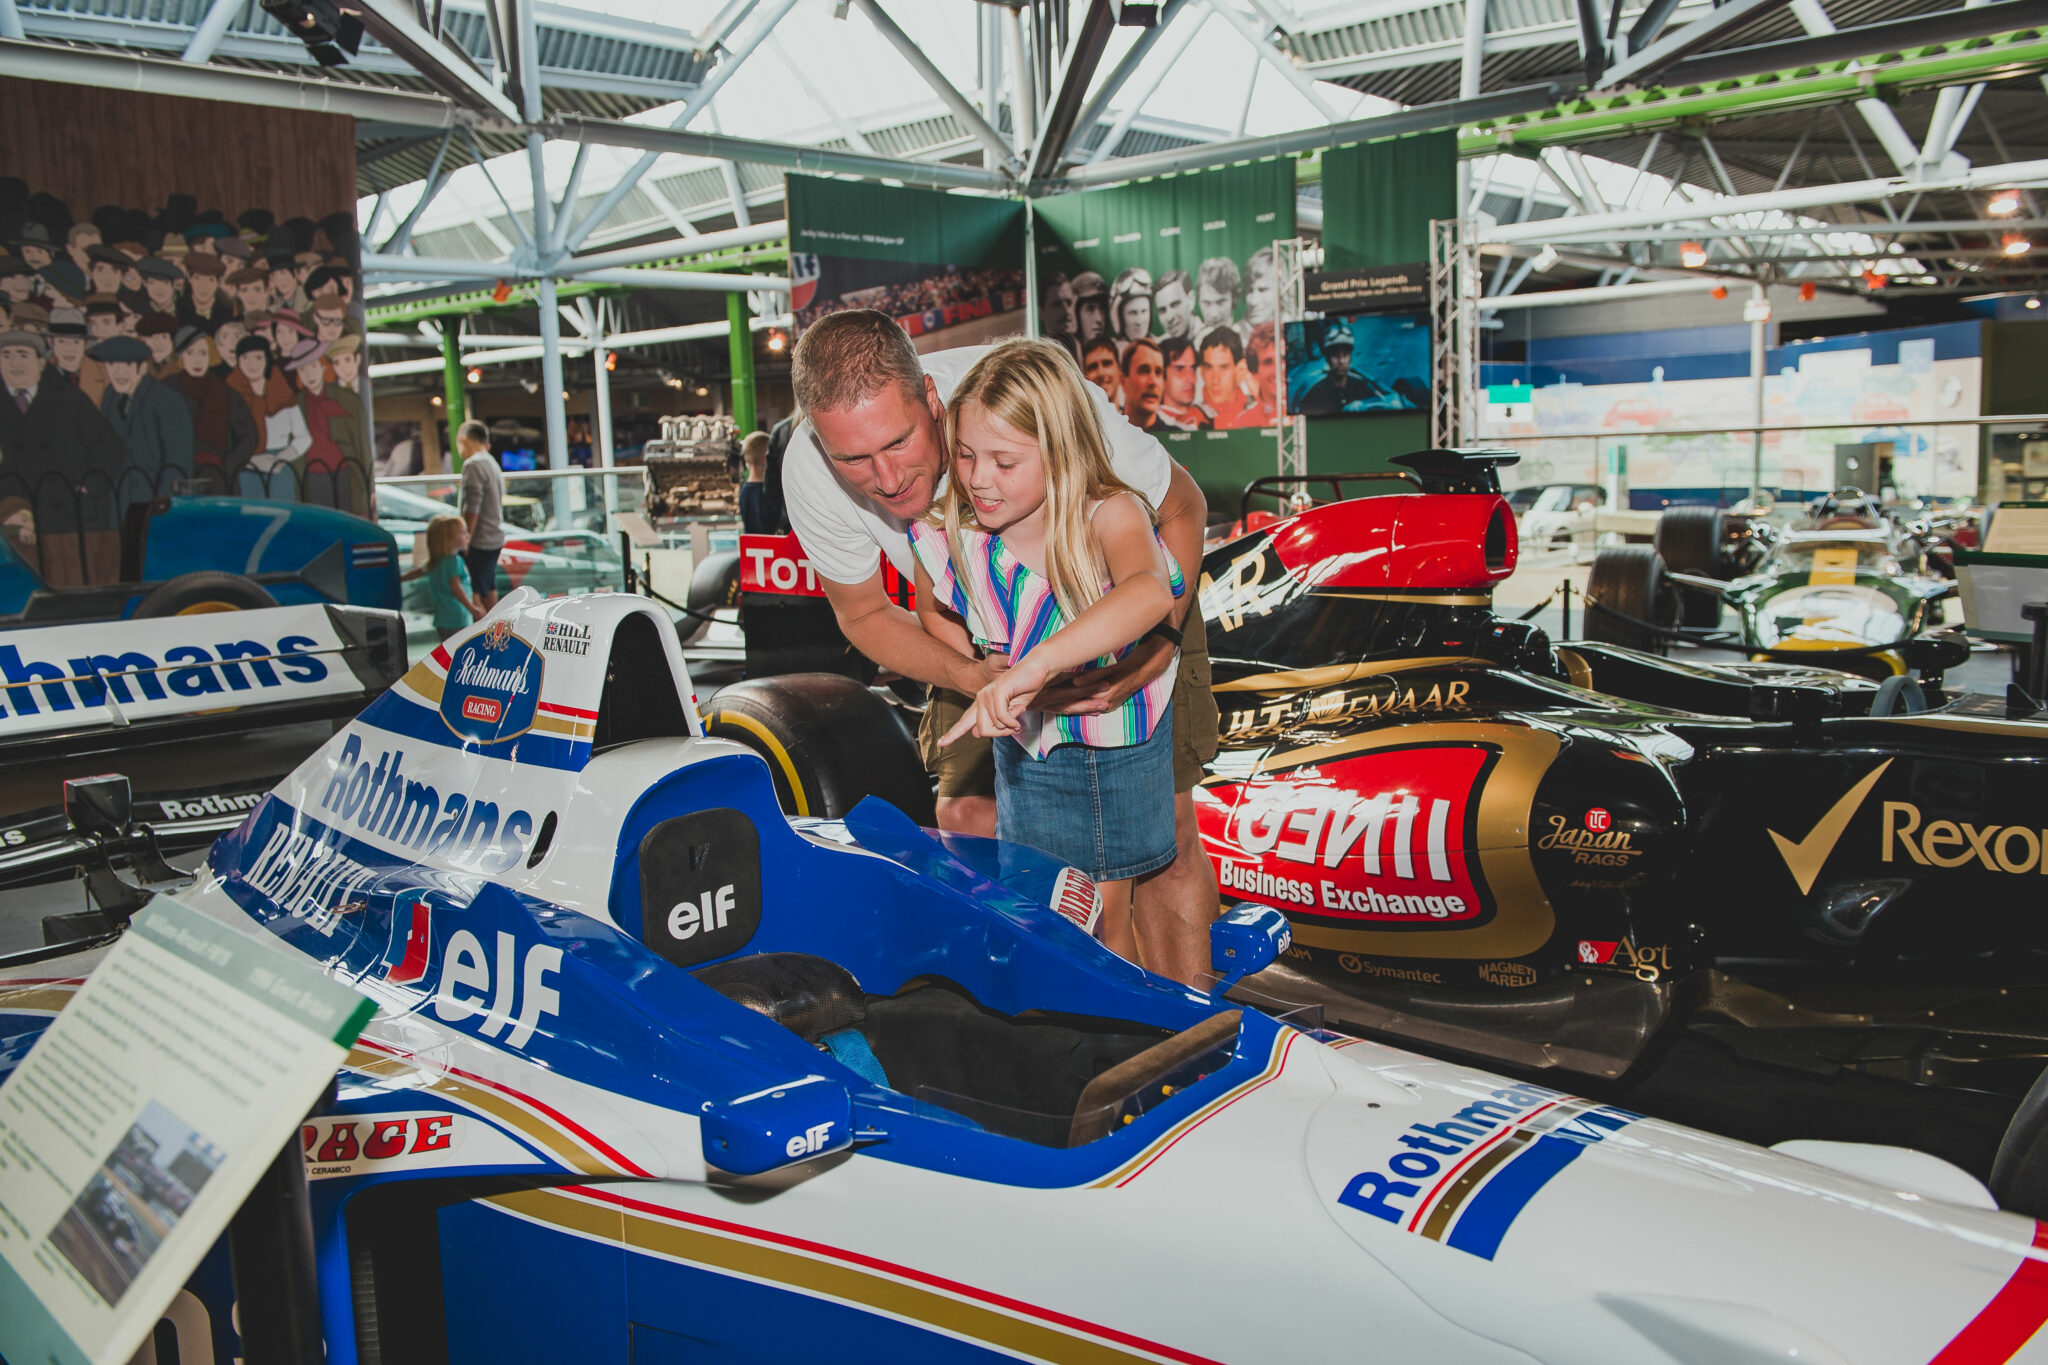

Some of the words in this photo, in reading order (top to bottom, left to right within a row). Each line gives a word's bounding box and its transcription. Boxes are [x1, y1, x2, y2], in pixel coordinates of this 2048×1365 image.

[1320, 280, 1349, 292] Grand
[1350, 278, 1369, 288] Prix
[1370, 274, 1408, 287] Legends
[946, 299, 993, 325] FINA
[240, 504, 291, 576] 7
[543, 636, 590, 656] RENAULT
[558, 624, 591, 640] HILL
[0, 635, 328, 719] hmans
[454, 647, 529, 695] Rothmans
[466, 702, 496, 717] RACING
[322, 733, 533, 875] Rothmans
[1538, 815, 1633, 855] Japan
[1574, 853, 1630, 867] RAGS
[241, 822, 379, 938] RENAULT
[1220, 858, 1314, 906] Business
[1321, 880, 1466, 918] Exchange
[667, 883, 736, 940] elf
[1277, 930, 1292, 955] elf
[1606, 935, 1673, 982] Agt
[434, 929, 564, 1050] elf
[1363, 961, 1442, 984] Symantec
[786, 1121, 835, 1157] elf
[311, 1165, 352, 1175] CERAMICO
